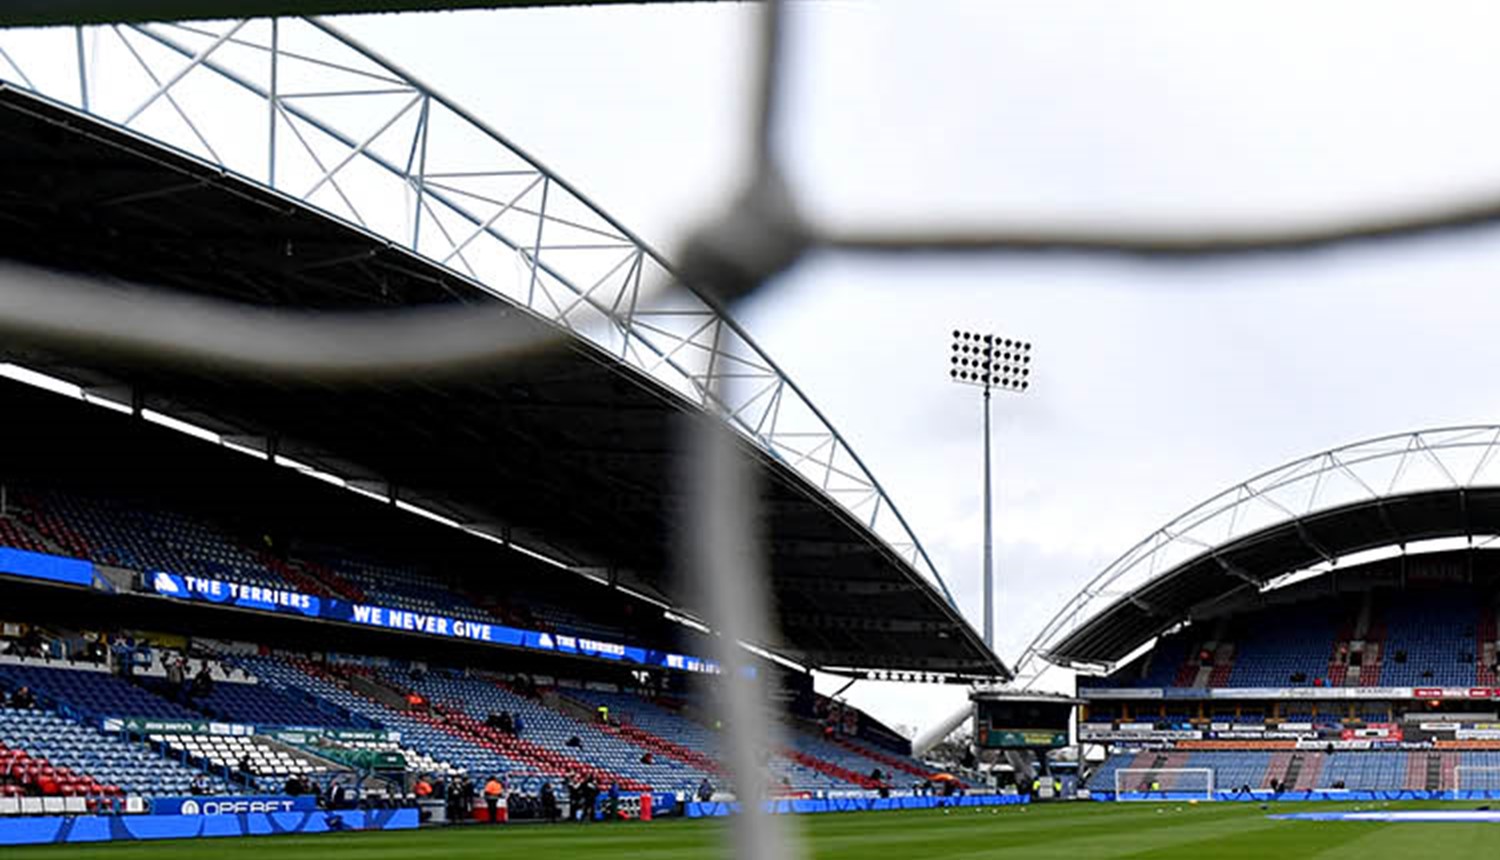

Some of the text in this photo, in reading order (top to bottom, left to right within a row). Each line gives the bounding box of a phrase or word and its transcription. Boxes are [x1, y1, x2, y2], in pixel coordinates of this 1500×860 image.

[184, 575, 311, 608] THE TERRIERS
[352, 604, 492, 640] WE NEVER GIVE
[555, 634, 625, 655] THE TERRIERS
[666, 653, 684, 668] WE
